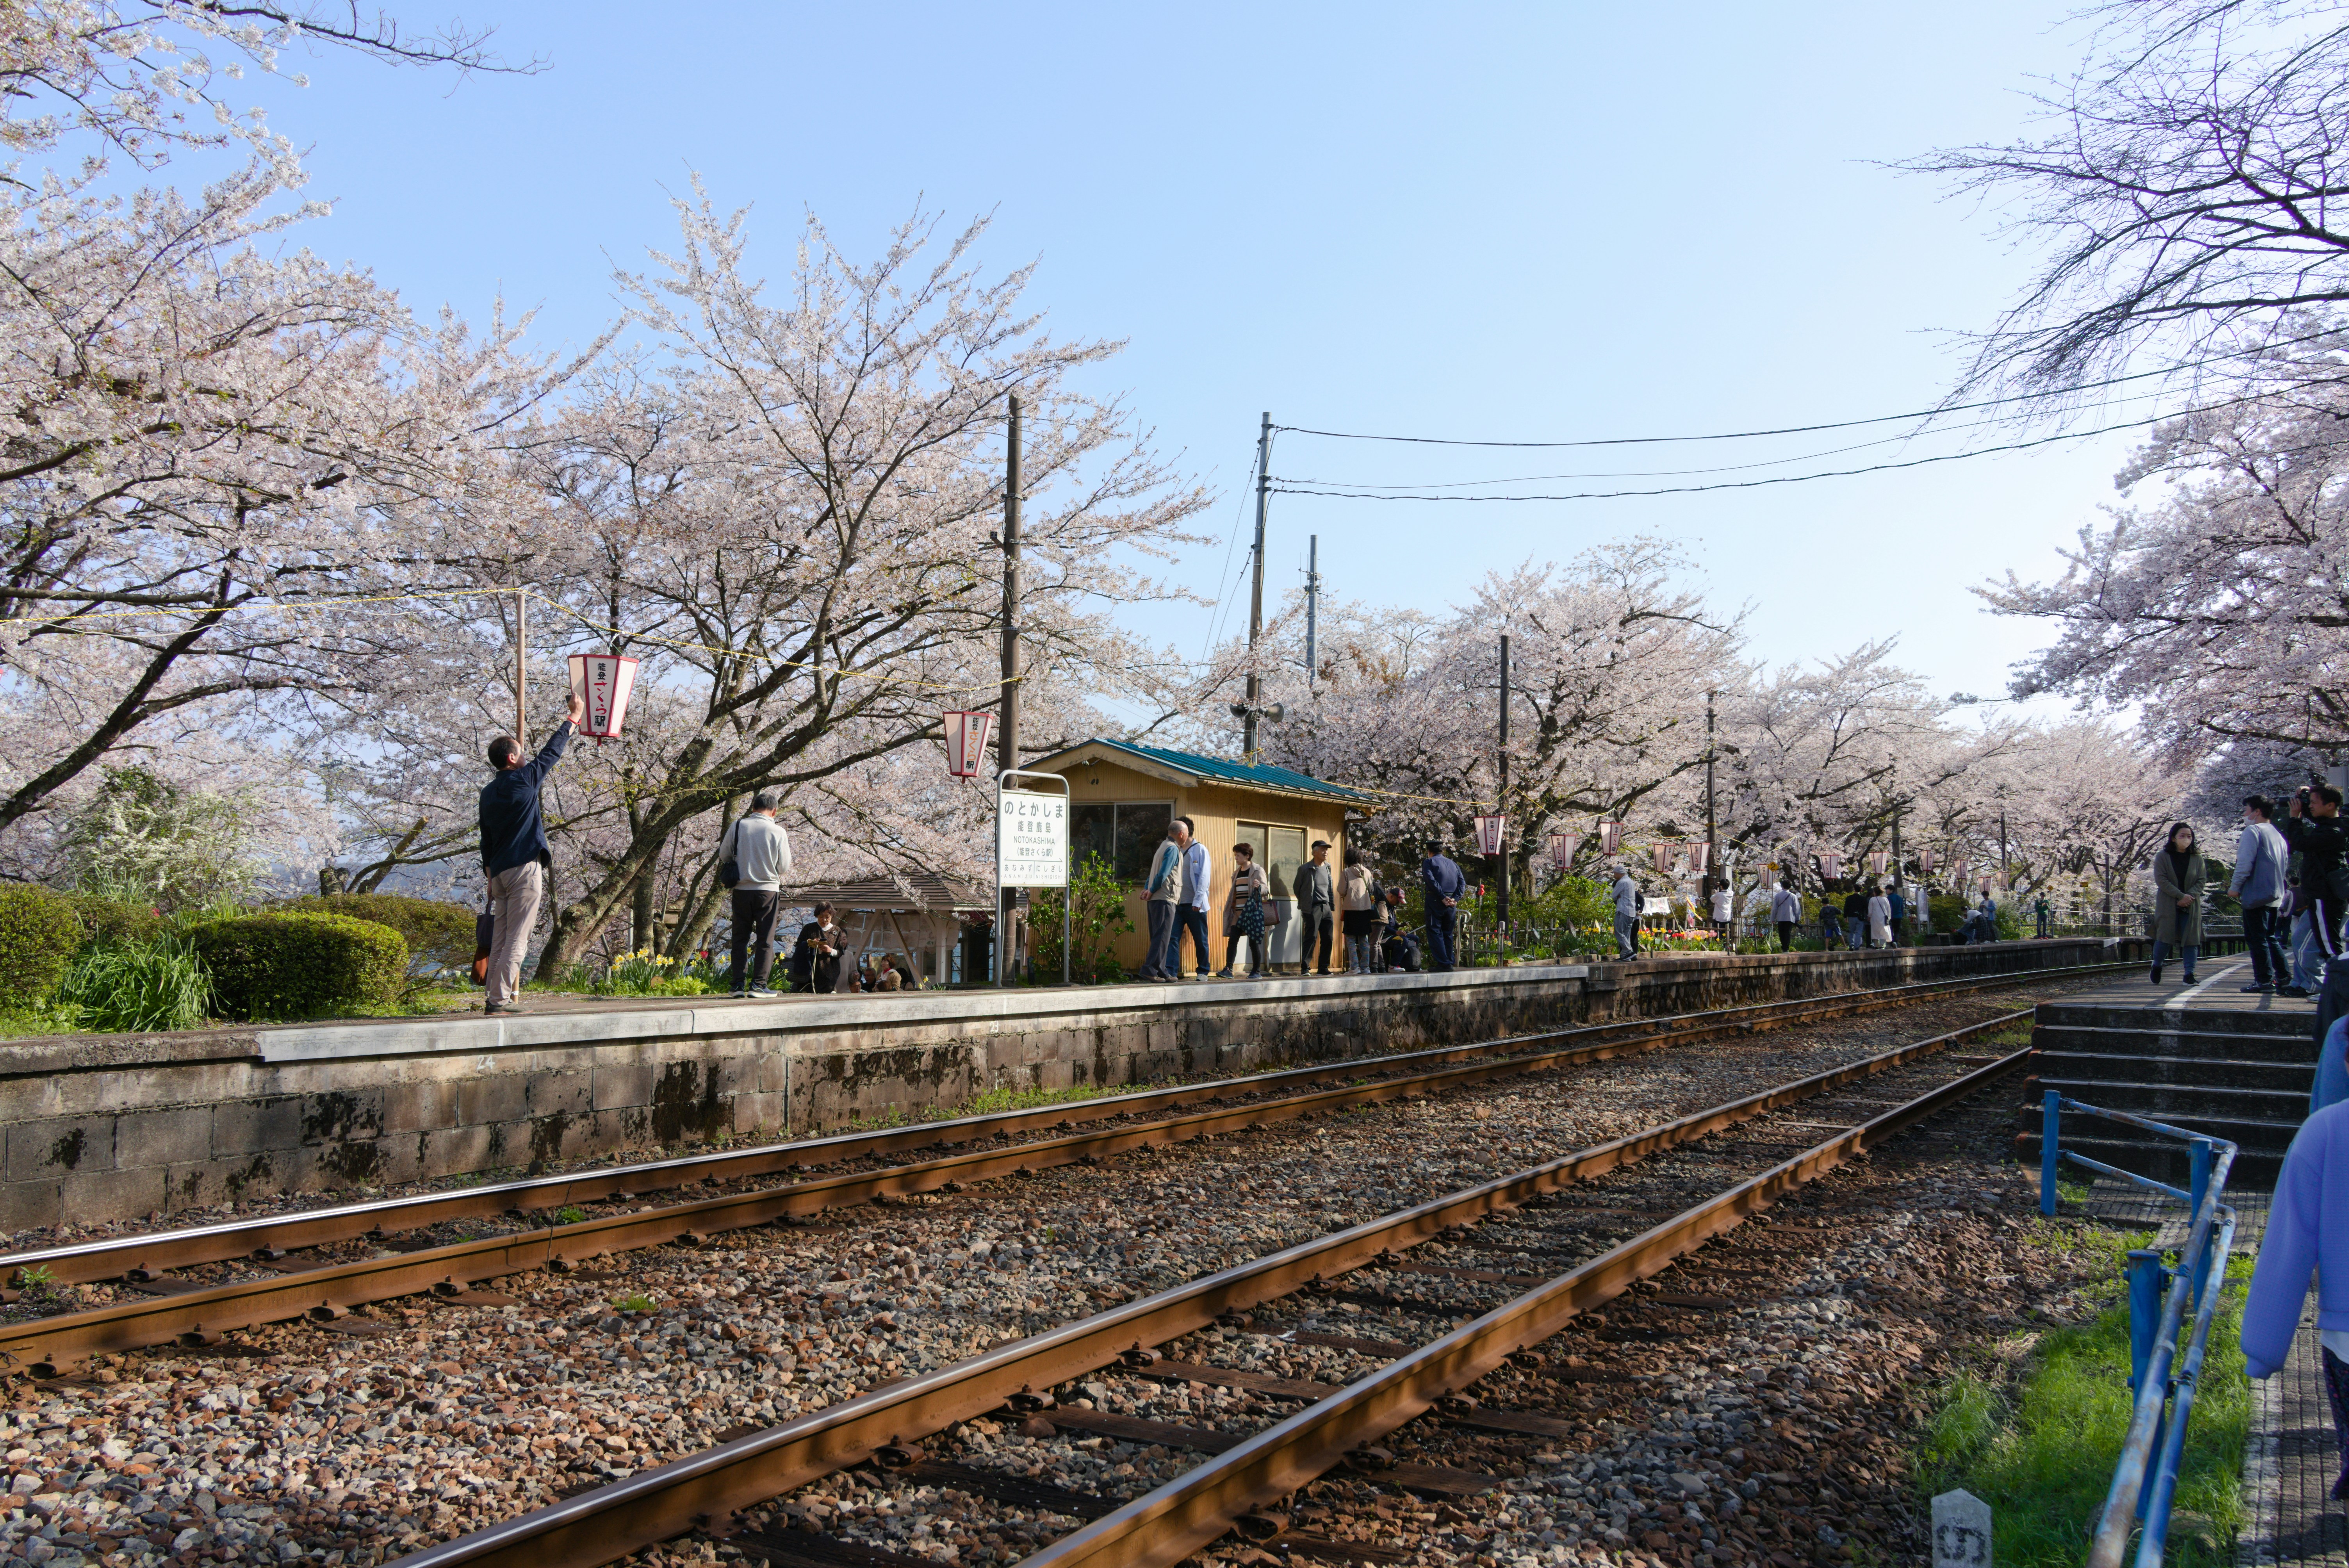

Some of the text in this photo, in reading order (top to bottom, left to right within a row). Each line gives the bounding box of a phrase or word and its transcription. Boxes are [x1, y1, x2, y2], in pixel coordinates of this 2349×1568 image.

[594, 663, 608, 727] 能登さくら駅
[966, 717, 979, 770] 能登さくら駅
[1004, 801, 1063, 818] のとかしま
[1018, 820, 1051, 833] 能登鹿島
[1014, 836, 1055, 845] NOTOKASHIMA
[1017, 847, 1053, 857] (能登さくら駅)
